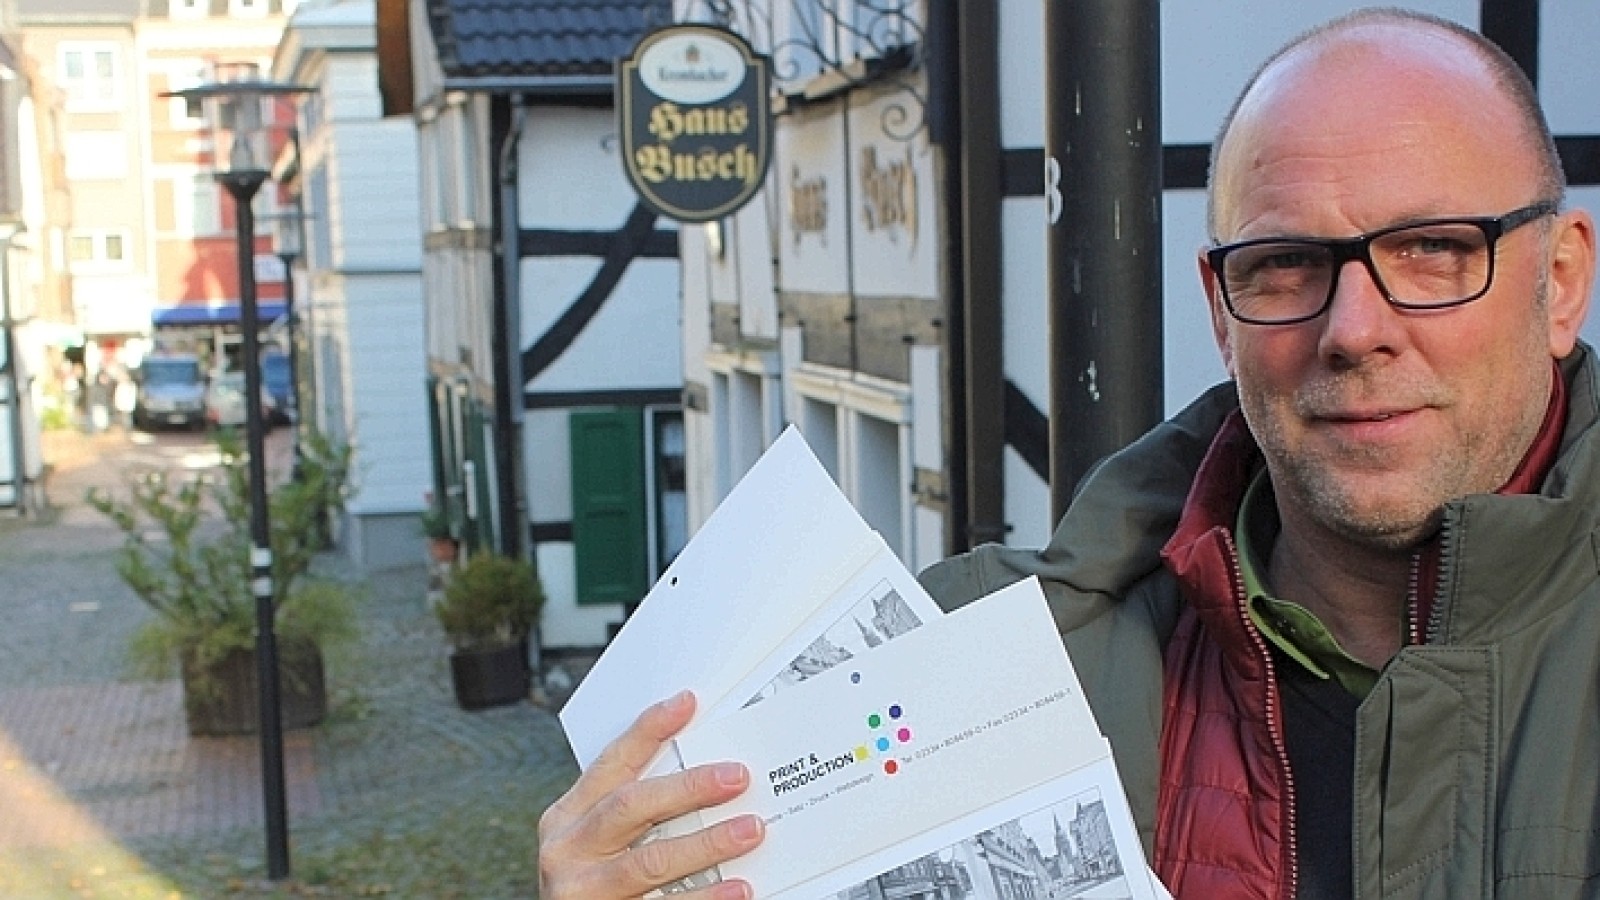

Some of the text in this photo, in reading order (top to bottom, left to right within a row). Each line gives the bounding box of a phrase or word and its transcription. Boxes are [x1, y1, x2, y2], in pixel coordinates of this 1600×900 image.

[649, 102, 748, 140] Haus
[636, 144, 756, 186] Busch
[769, 752, 819, 783] PRINT &
[773, 750, 854, 796] PRODUCTION
